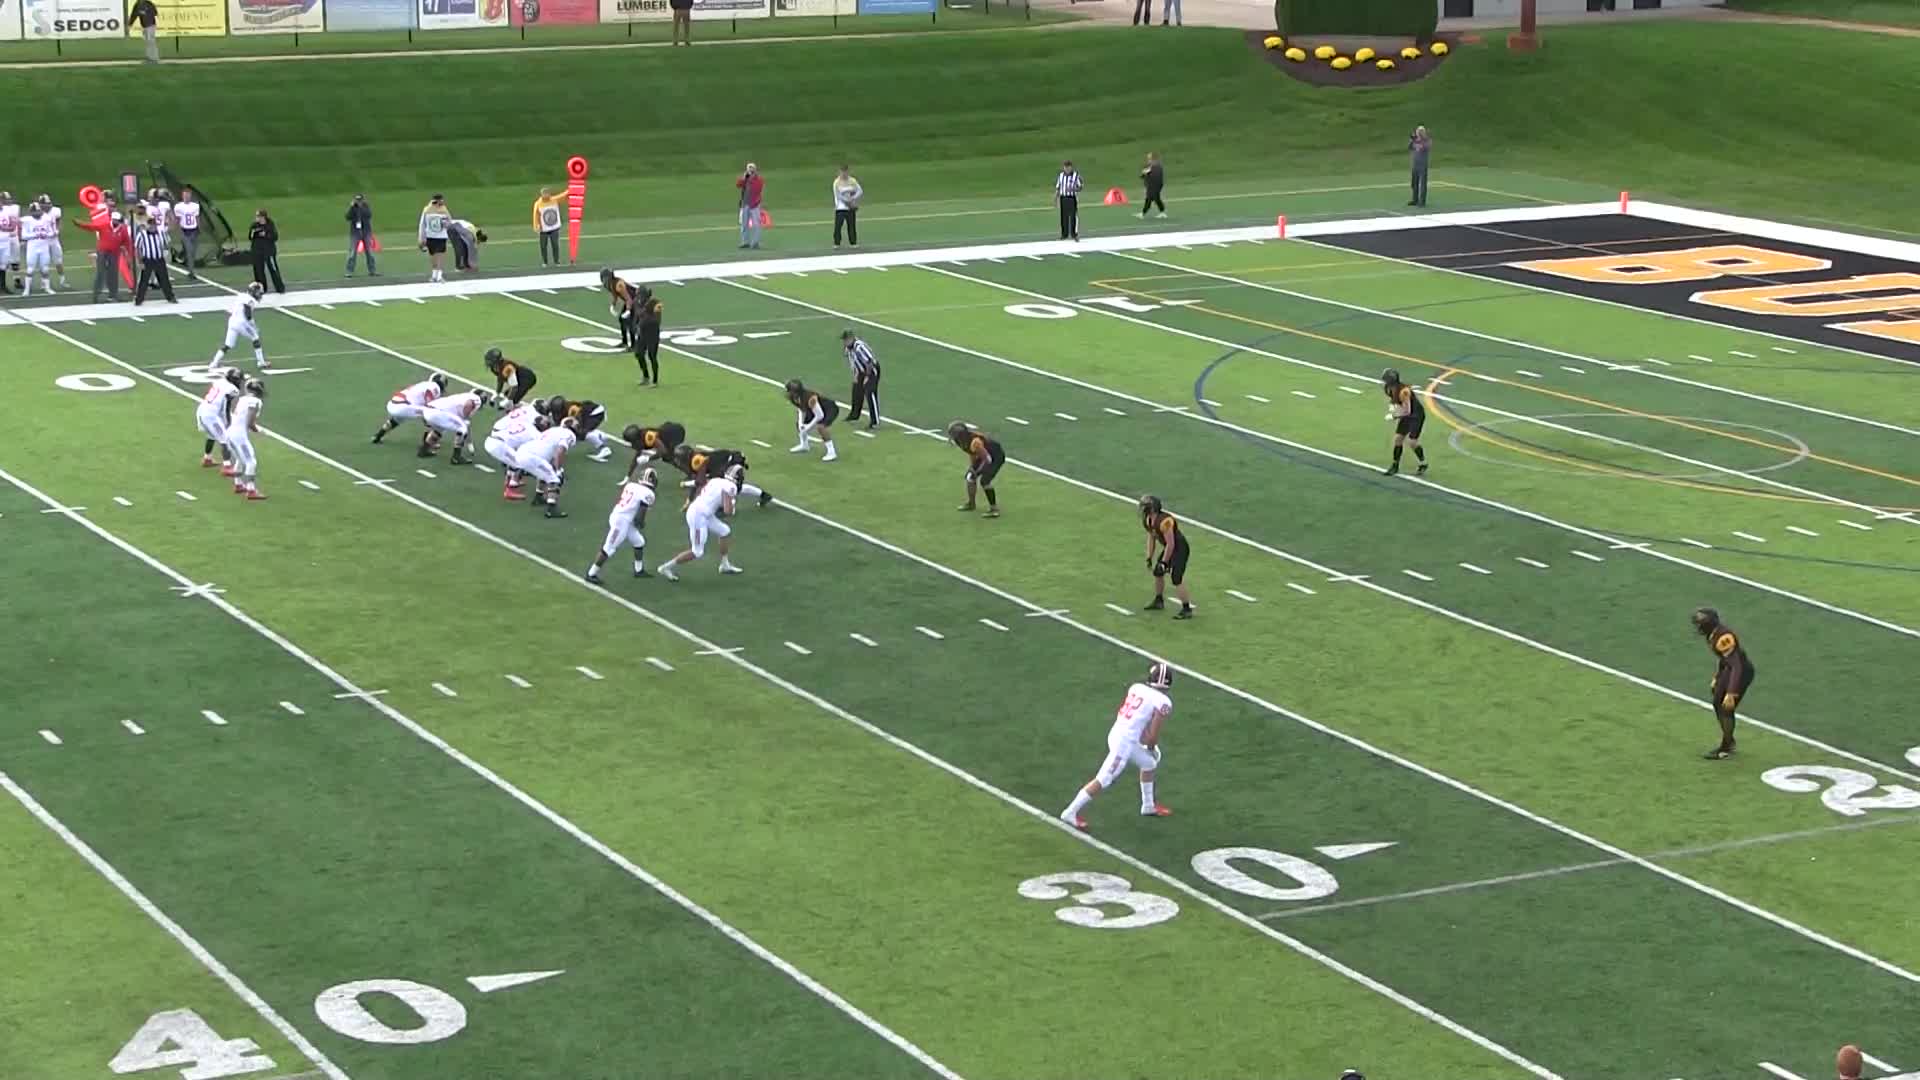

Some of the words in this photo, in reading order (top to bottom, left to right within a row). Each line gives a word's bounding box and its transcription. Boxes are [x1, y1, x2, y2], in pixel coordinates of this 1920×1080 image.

[54, 19, 120, 32] SEDCO
[1760, 745, 1920, 817] 2
[1016, 846, 1340, 929] 30
[107, 978, 468, 1080] 40
